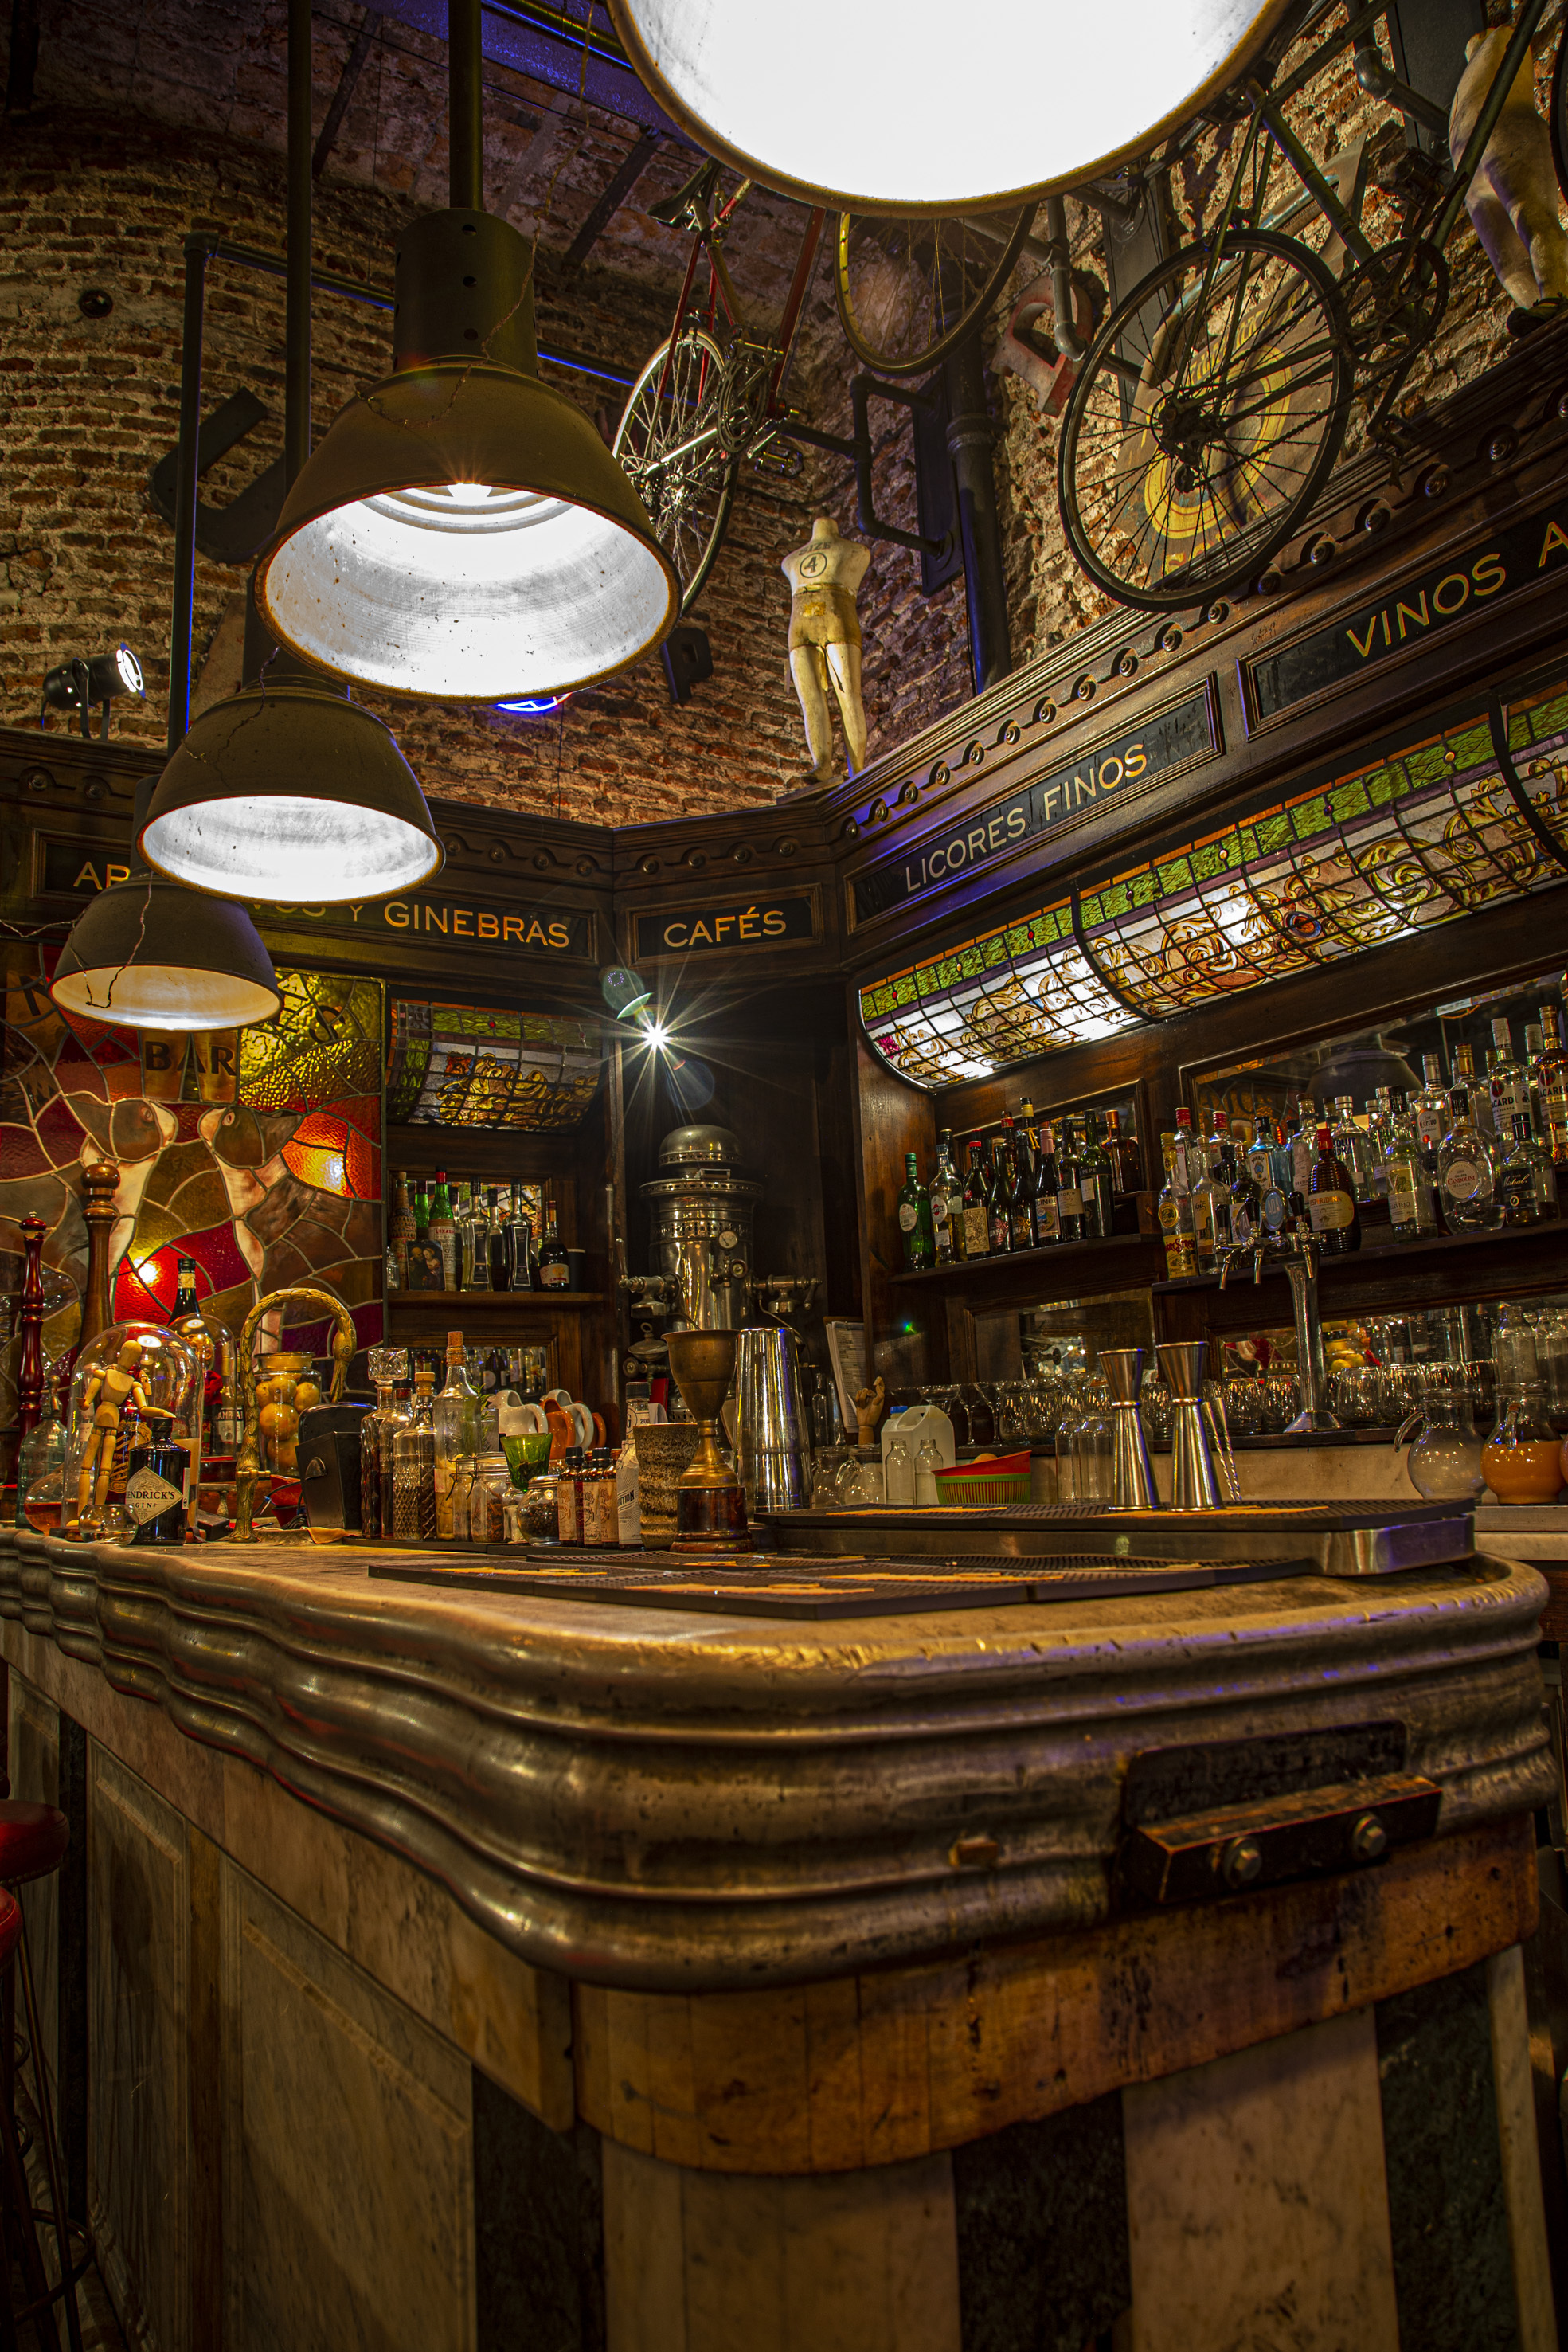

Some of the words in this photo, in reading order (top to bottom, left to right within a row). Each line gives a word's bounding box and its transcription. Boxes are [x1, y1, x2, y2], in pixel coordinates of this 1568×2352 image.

[798, 542, 831, 556] SIZE
[804, 556, 817, 573] 4
[1346, 554, 1506, 657] VINOS
[905, 808, 1026, 892] LICORES
[1043, 744, 1147, 821] FINOS
[384, 902, 569, 948] GINEBRAS
[664, 906, 786, 948] CAFÉS
[145, 1040, 237, 1076] BAR
[1539, 1083, 1568, 1098] ACARDÍ
[1492, 1093, 1518, 1108] ACARDÍ
[1333, 1137, 1355, 1148] SOLUT
[1333, 1145, 1352, 1156] ODKA
[1310, 1196, 1342, 1206] ESPERIDINA
[216, 1411, 243, 1420] AMPI
[126, 1490, 175, 1500] ENDRICK'S
